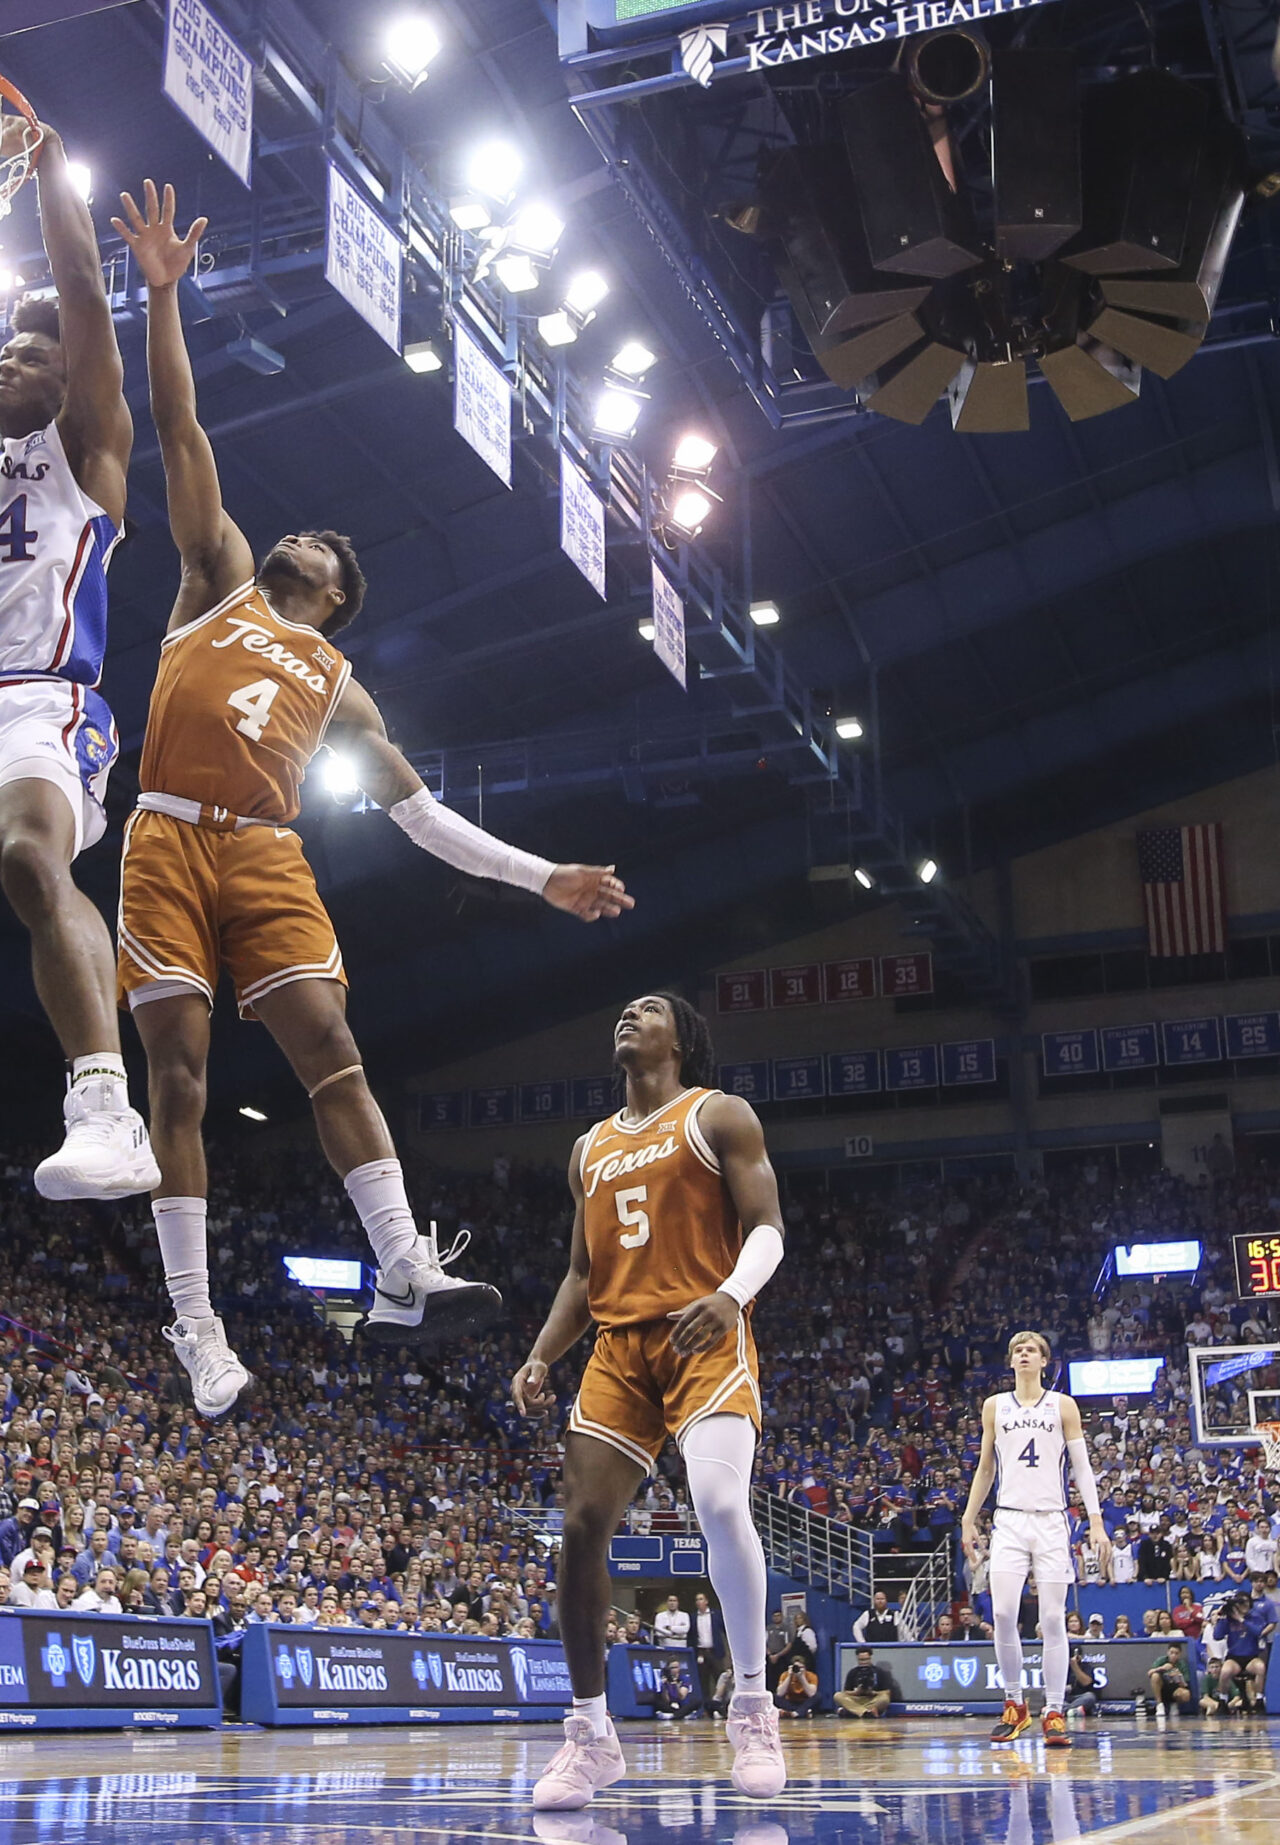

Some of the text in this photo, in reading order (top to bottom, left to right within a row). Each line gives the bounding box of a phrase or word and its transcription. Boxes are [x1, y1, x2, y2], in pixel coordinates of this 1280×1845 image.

[747, 0, 823, 38] THE
[746, 0, 1048, 72] KANSAS HEAL
[173, 7, 246, 111] CHAMPIONS
[347, 189, 365, 226] BIG
[334, 202, 396, 287] CHAMPIONS
[212, 617, 327, 695] Texas
[227, 678, 281, 742] 4
[840, 972, 859, 990] 12
[896, 967, 917, 984] 33
[732, 984, 750, 1002] 21
[787, 977, 804, 995] 31
[1182, 1032, 1202, 1051] 14
[1241, 1026, 1267, 1046] 25
[1059, 1043, 1083, 1062] 40
[1120, 1038, 1140, 1057] 15
[902, 1059, 921, 1078] 13
[959, 1054, 979, 1072] 15
[790, 1069, 808, 1088] 13
[844, 1064, 865, 1083] 32
[733, 1075, 755, 1093] 25
[848, 1137, 870, 1155] 10
[586, 1136, 679, 1198] Texas
[615, 1184, 650, 1250] 5
[1002, 1419, 1055, 1434] KANSAS
[1018, 1437, 1040, 1468] 4
[673, 1537, 702, 1549] TEXAS
[618, 1563, 641, 1571] PERIOD
[122, 1635, 196, 1652] BlueCross BlueShield
[100, 1649, 201, 1691] Kansas
[316, 1657, 388, 1691] Kansas
[444, 1661, 504, 1692] Kansas
[985, 1663, 1109, 1690] Kans
